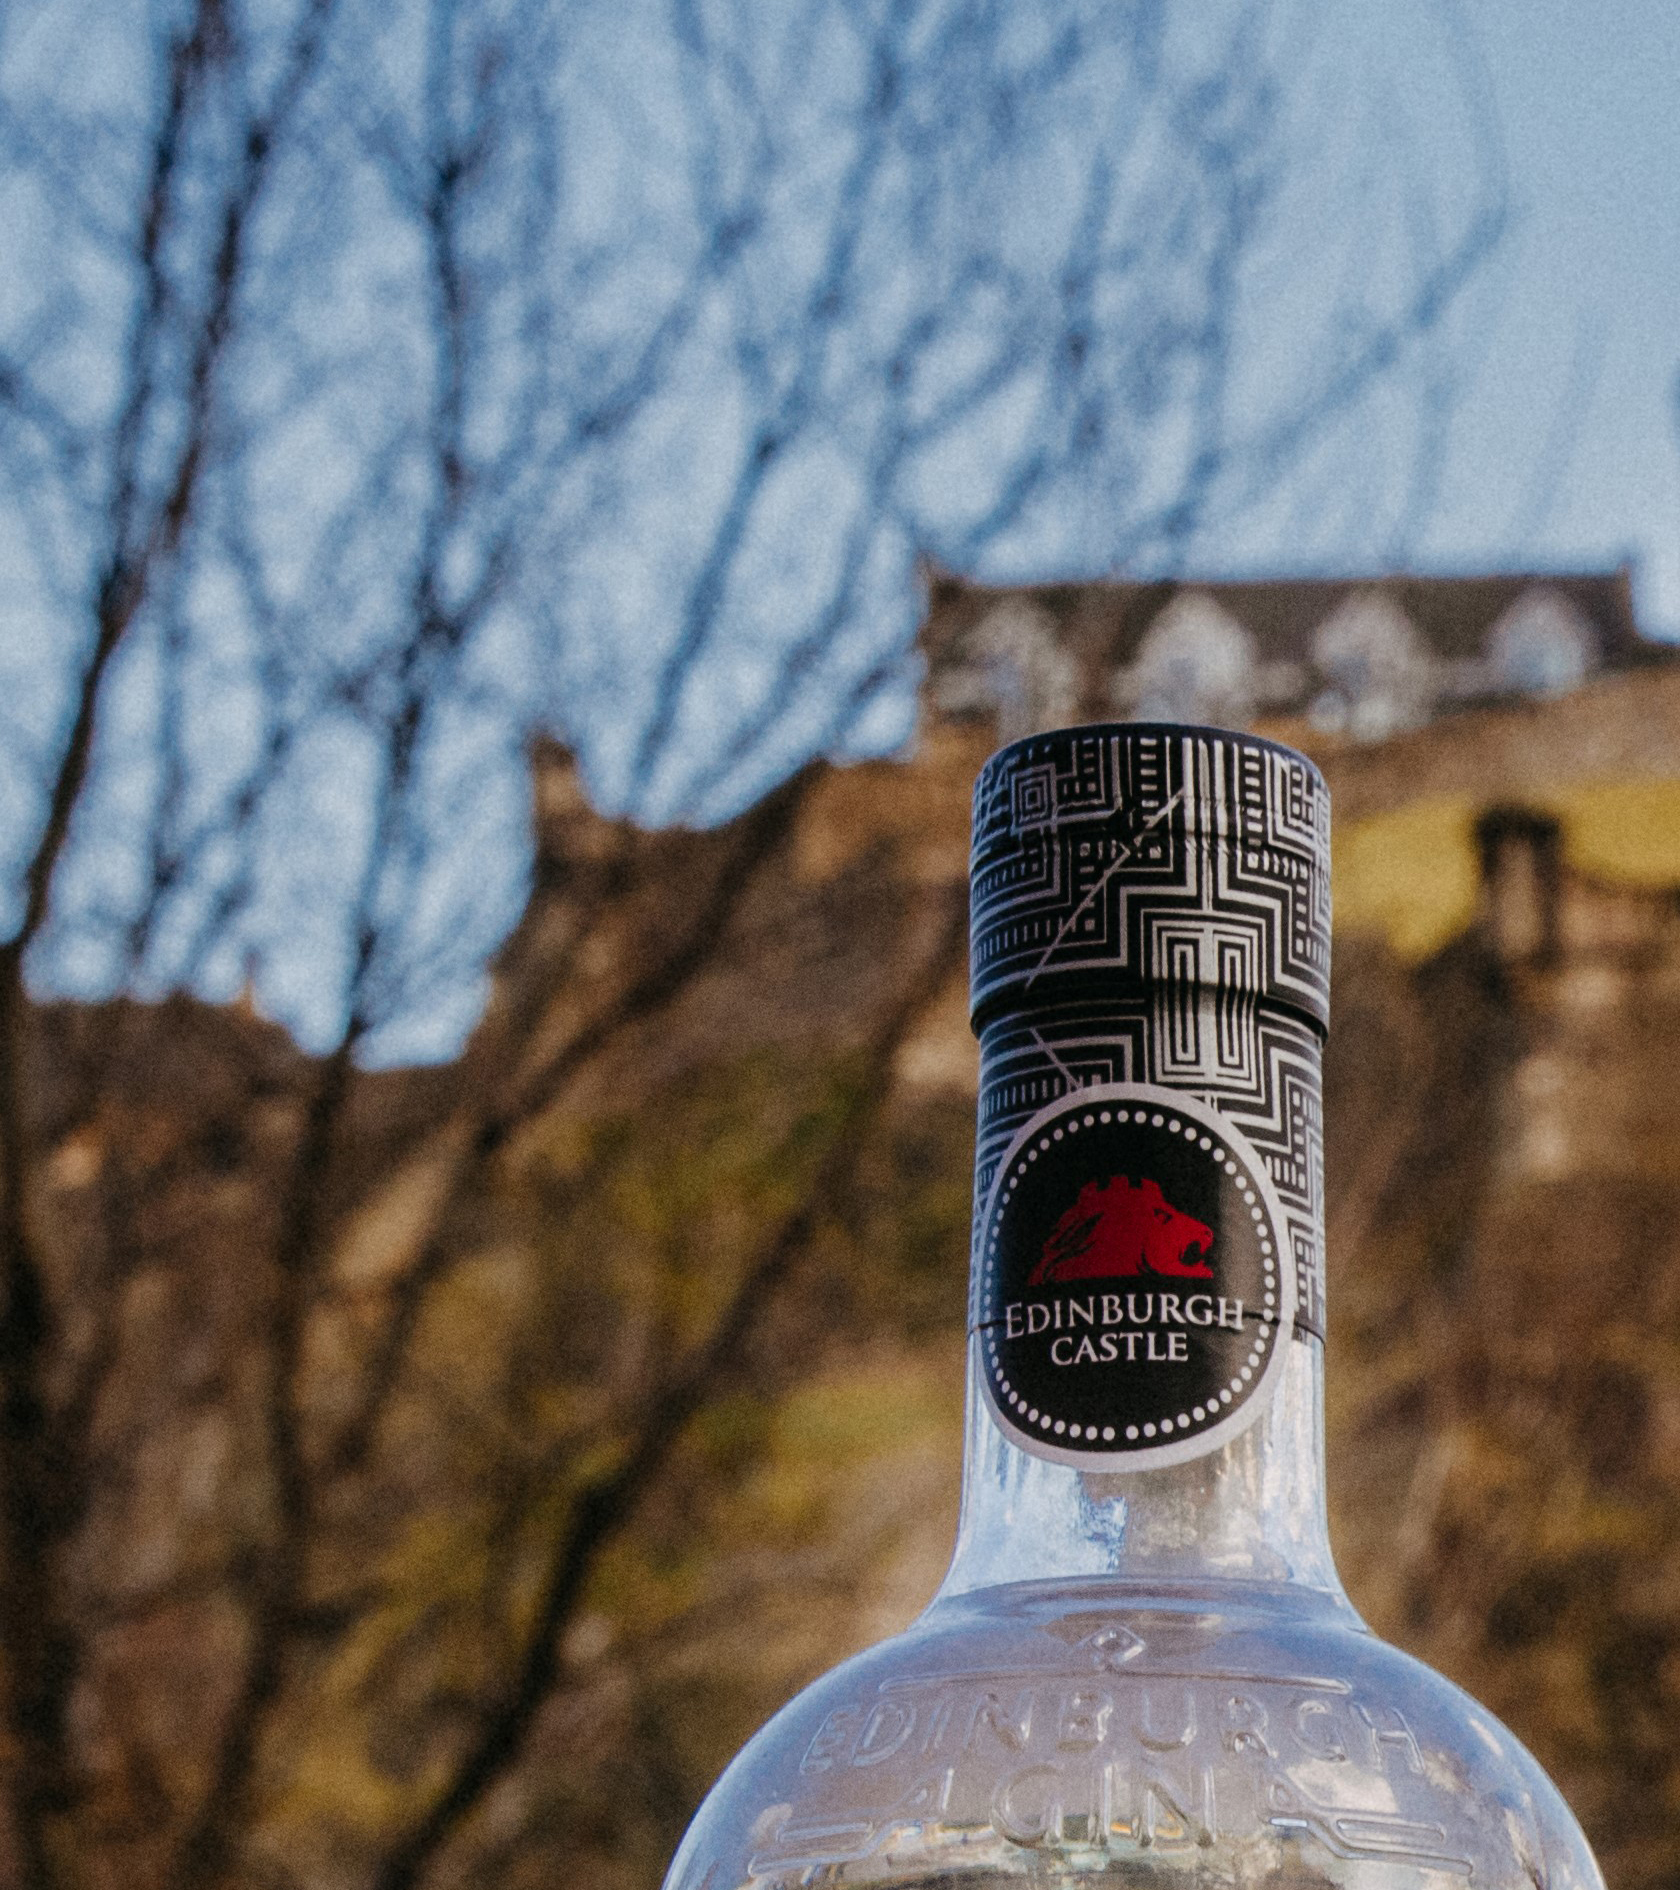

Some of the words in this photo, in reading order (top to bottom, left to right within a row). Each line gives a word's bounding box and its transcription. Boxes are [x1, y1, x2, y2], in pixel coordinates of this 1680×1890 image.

[1006, 1293, 1245, 1339] EDINBURGH
[1051, 1332, 1189, 1366] CASTLE
[798, 1690, 1426, 1776] EDINBURGH
